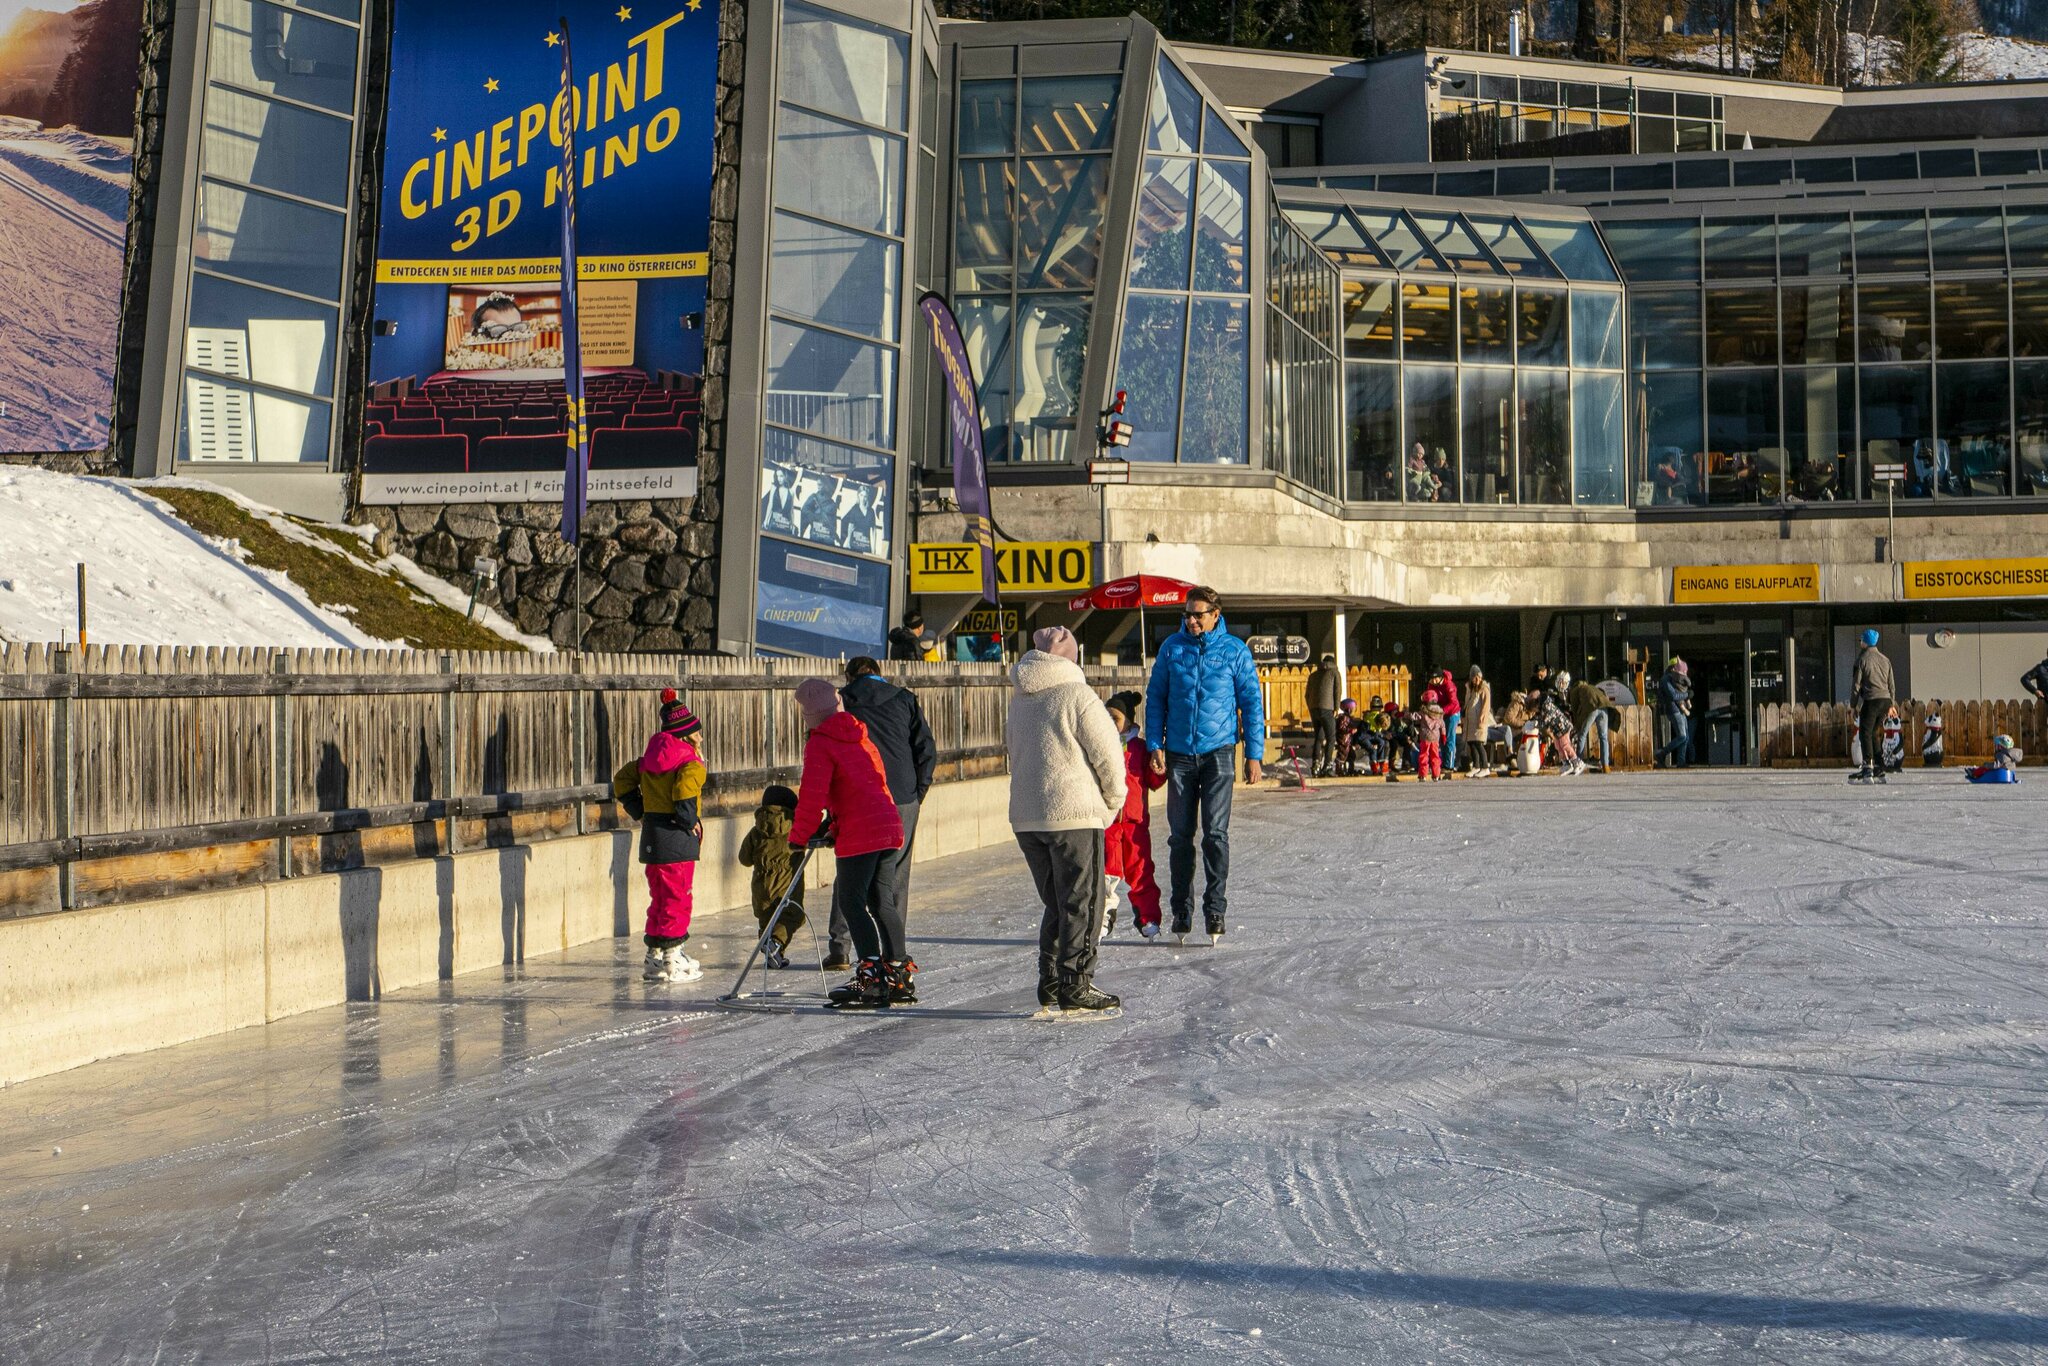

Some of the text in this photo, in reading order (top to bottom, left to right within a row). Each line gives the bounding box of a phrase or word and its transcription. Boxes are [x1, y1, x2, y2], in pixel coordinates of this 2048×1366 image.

[400, 11, 685, 220] CINEPOINT
[451, 189, 522, 252] 3D
[543, 107, 681, 208] KINO
[390, 266, 449, 277] ENTDECKEN
[452, 266, 467, 276] SIE
[470, 266, 493, 276] HIER
[497, 265, 515, 275] DAS
[583, 263, 595, 273] 3D
[600, 262, 624, 272] KINO
[628, 259, 696, 272] ÖSTERREICHS!
[386, 480, 519, 495] www.cinepoint.at
[534, 475, 673, 493] #cinointseefeld
[919, 548, 974, 572] THX
[995, 548, 1086, 584] KINO
[1680, 577, 1812, 590] EINGANG EISLAUFPLATZ
[1914, 569, 2048, 587] EISSTOCKSCHIESSE
[764, 608, 825, 623] CINEPOINT
